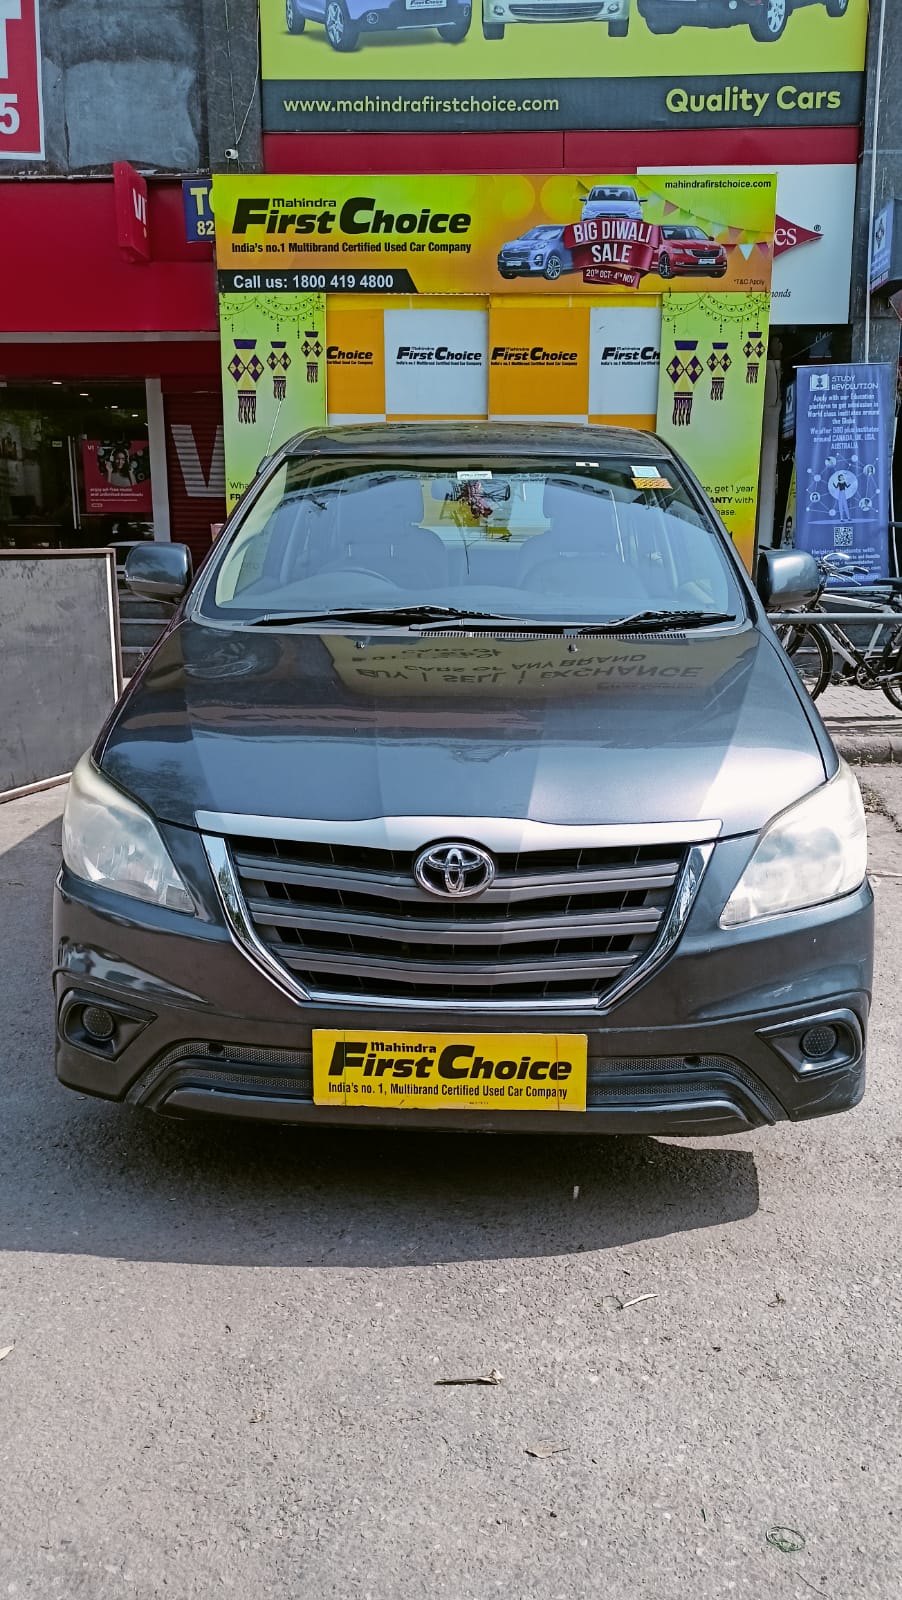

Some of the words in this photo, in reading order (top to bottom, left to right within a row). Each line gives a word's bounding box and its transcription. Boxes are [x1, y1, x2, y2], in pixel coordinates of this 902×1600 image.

[283, 95, 560, 113] www.mahindrafirstchoice.com
[665, 86, 770, 117] Quality
[776, 85, 841, 110] Cars
[665, 179, 772, 189] mahindrafirstchoice.com
[190, 186, 215, 216] T
[272, 198, 337, 208] Mahindra
[231, 198, 337, 234] First
[339, 197, 472, 235] Choice
[573, 221, 598, 243] BIG
[601, 220, 653, 243] DIWALI
[231, 242, 264, 253] India's
[265, 242, 286, 253] no.1
[288, 242, 340, 253] Multibrand
[341, 242, 382, 253] Certified
[384, 242, 408, 253] Used
[409, 242, 426, 253] Car
[428, 242, 472, 254] Company
[591, 243, 633, 263] SALE
[233, 275, 261, 289] Call
[265, 277, 288, 289] us:
[292, 275, 326, 289] 1800
[330, 275, 356, 289] 419
[360, 275, 394, 289] 4800
[326, 346, 374, 360] Choice
[396, 347, 434, 360] First
[435, 347, 482, 361] Choice
[491, 347, 529, 361] First
[530, 347, 578, 361] Choice
[601, 346, 640, 361] First
[831, 375, 856, 383] STUDY
[831, 383, 879, 391] REVOLUTION
[714, 486, 729, 494] get
[735, 486, 755, 494] year
[734, 496, 754, 504] with
[370, 1041, 437, 1054] Mahindra
[327, 1041, 435, 1078] First
[437, 1044, 573, 1081] Choice
[328, 1082, 359, 1094] India's
[361, 1084, 375, 1094] no.
[390, 1083, 439, 1096] Multibrand
[441, 1084, 480, 1097] Certified
[482, 1085, 505, 1097] Used
[507, 1085, 523, 1097] Car
[525, 1086, 568, 1100] Company
